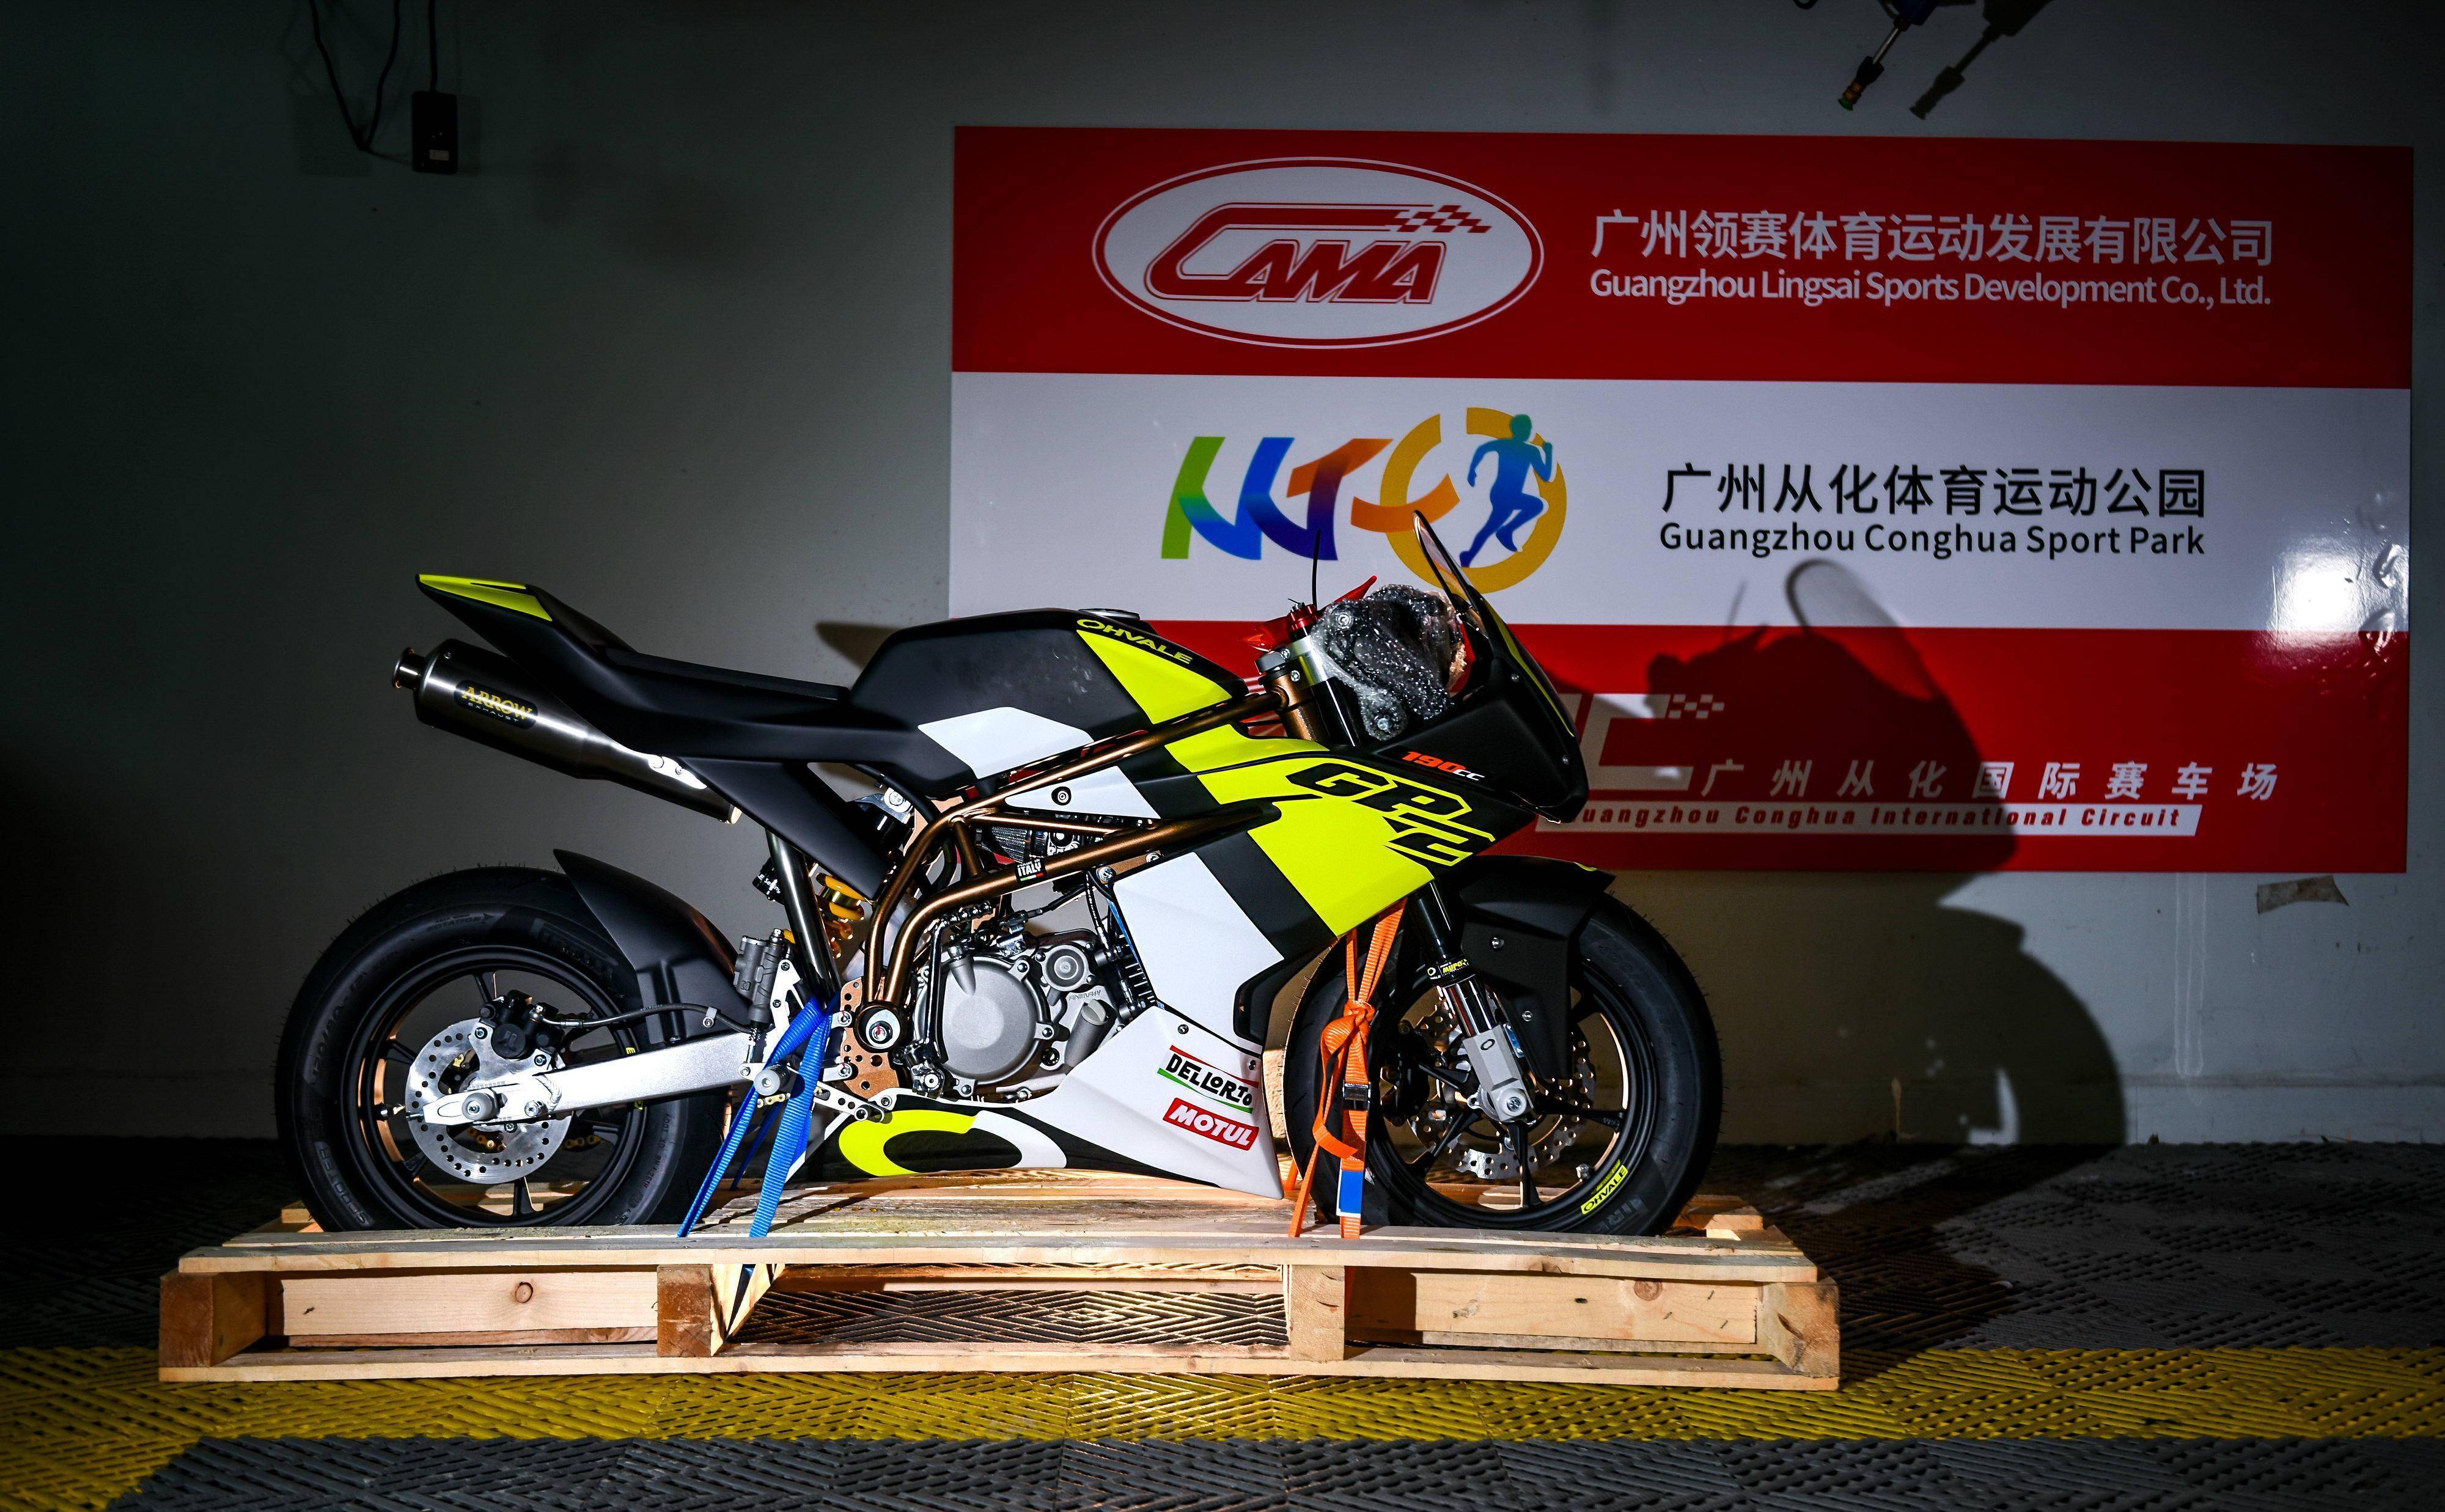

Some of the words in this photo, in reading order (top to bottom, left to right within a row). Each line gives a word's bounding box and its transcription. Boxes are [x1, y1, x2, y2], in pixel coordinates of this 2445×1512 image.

[1144, 202, 1491, 304] CAMA
[1590, 208, 2272, 266] 广州领赛体育运动发展有限公司
[1590, 268, 1756, 306] Guangzhou
[1762, 269, 1861, 307] Lingsai
[1866, 271, 1960, 307] Sports
[1965, 272, 2157, 309] Development
[2161, 275, 2215, 310] Co.,
[2220, 276, 2271, 305] Ltd.
[1661, 462, 2205, 518] 广州从化体育运动公园
[1660, 521, 1855, 559] Guangzhou
[1864, 523, 2017, 560] Conghua
[2026, 525, 2121, 560] Sport
[2130, 525, 2205, 555] Park
[1076, 618, 1193, 664] OHVALE
[461, 686, 532, 720] ARROW
[1700, 758, 2278, 801] 广州从化国际赛车场
[1582, 806, 1719, 828] uangzhou
[1735, 806, 1855, 829] Conghua
[1870, 807, 2067, 828] International
[2080, 807, 2180, 828] Circuit
[1017, 862, 1042, 877] ITALY
[1168, 1104, 1254, 1147] MOTUL
[1583, 1167, 1627, 1211] OHVALE
